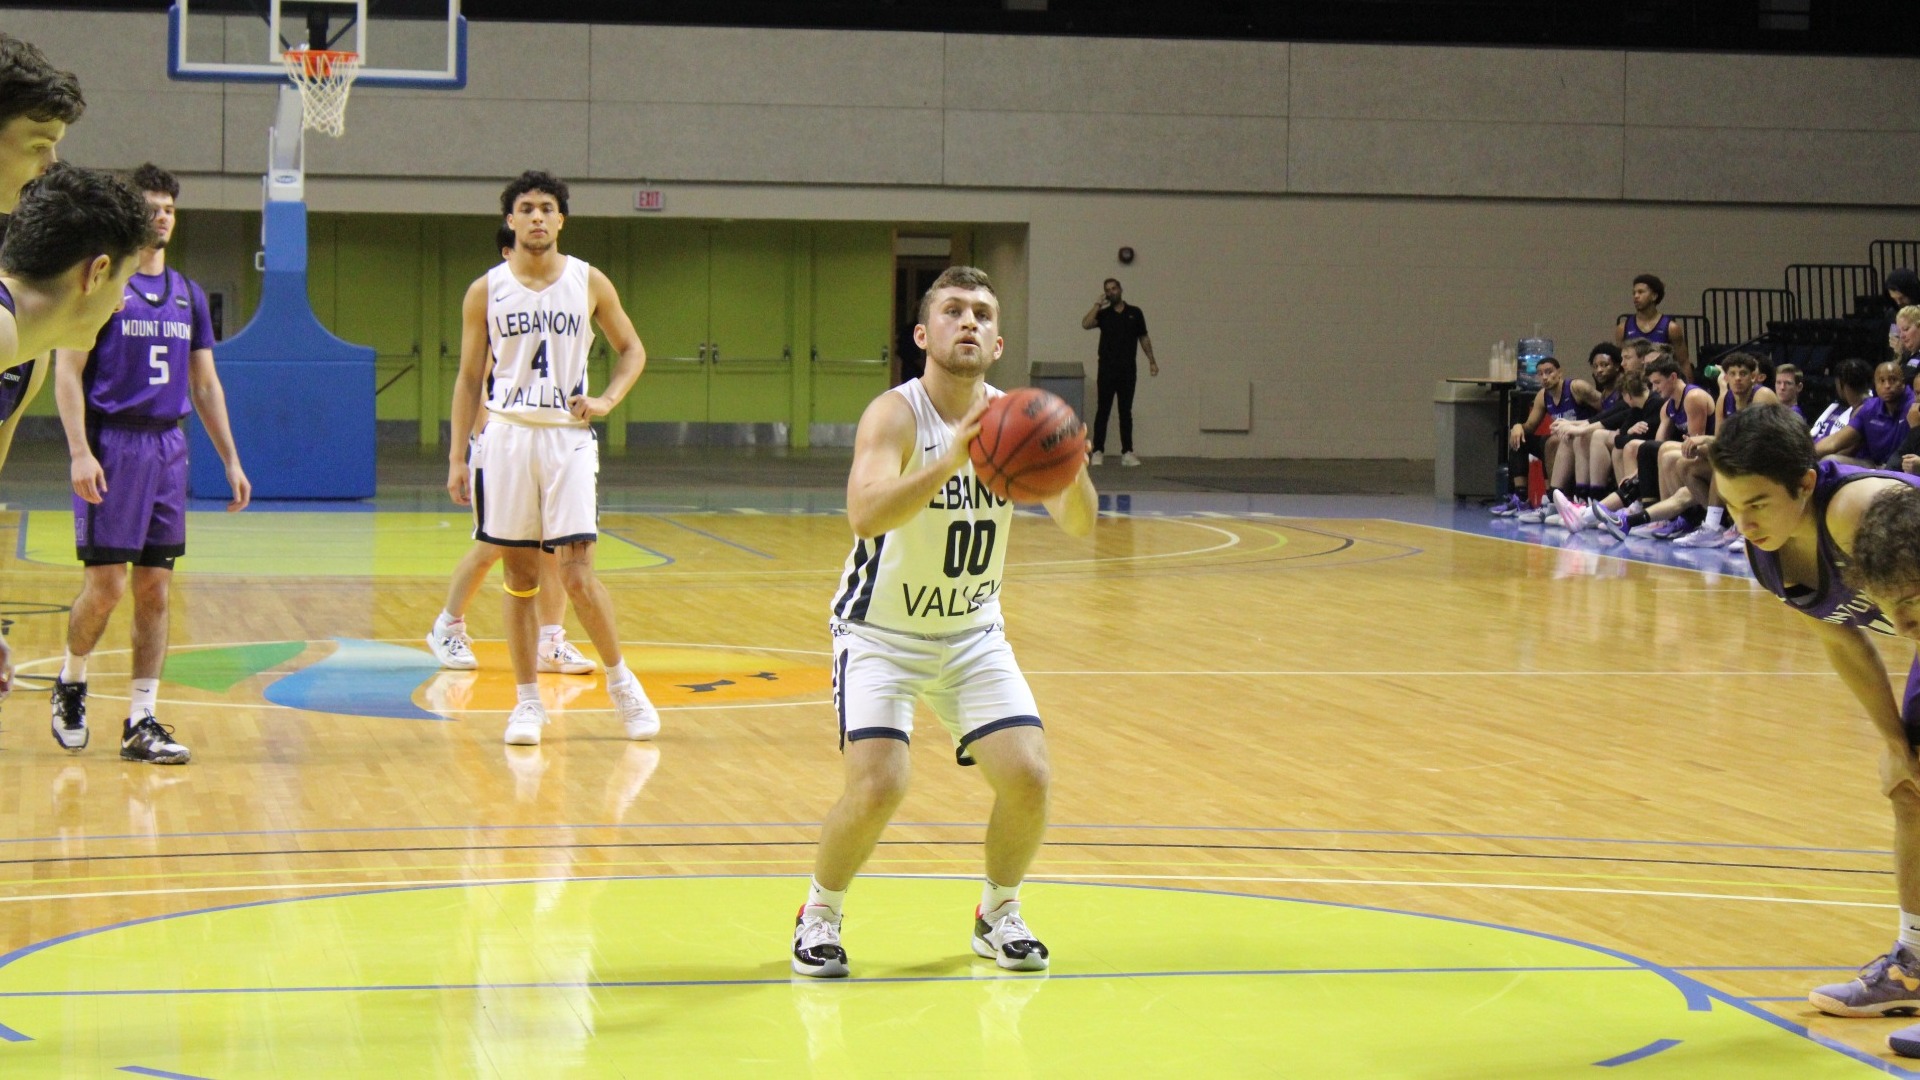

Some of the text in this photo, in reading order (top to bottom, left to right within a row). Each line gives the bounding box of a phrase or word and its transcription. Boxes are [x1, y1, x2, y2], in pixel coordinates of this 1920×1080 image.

[639, 191, 659, 206] EXIT
[122, 320, 191, 340] MOUNT UNION
[496, 311, 581, 338] LEBANON
[149, 345, 170, 385] 5
[531, 340, 548, 378] 4
[943, 519, 996, 579] 00
